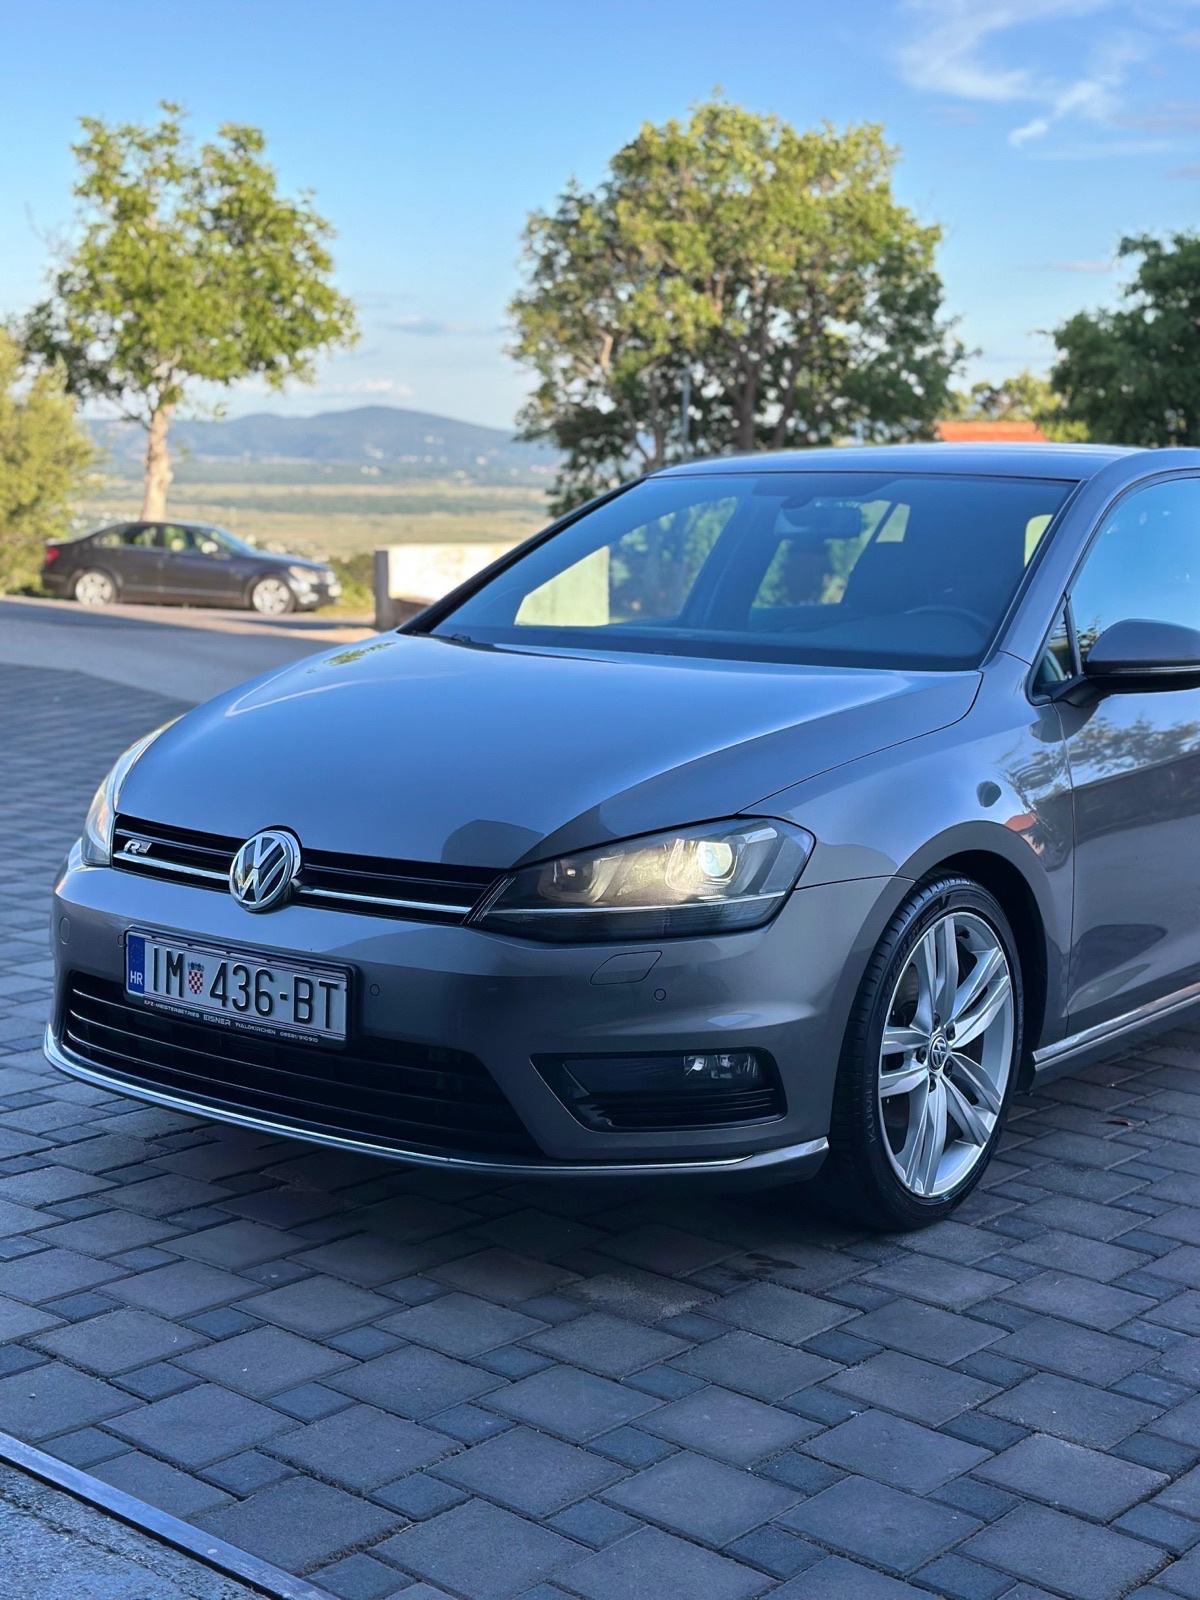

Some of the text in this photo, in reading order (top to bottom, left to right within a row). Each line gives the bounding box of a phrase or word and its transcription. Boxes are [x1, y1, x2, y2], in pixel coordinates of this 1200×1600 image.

[230, 831, 292, 907] VW
[130, 970, 144, 986] HR
[153, 947, 340, 1029] IM 436-BT
[203, 1013, 231, 1027] EISNER
